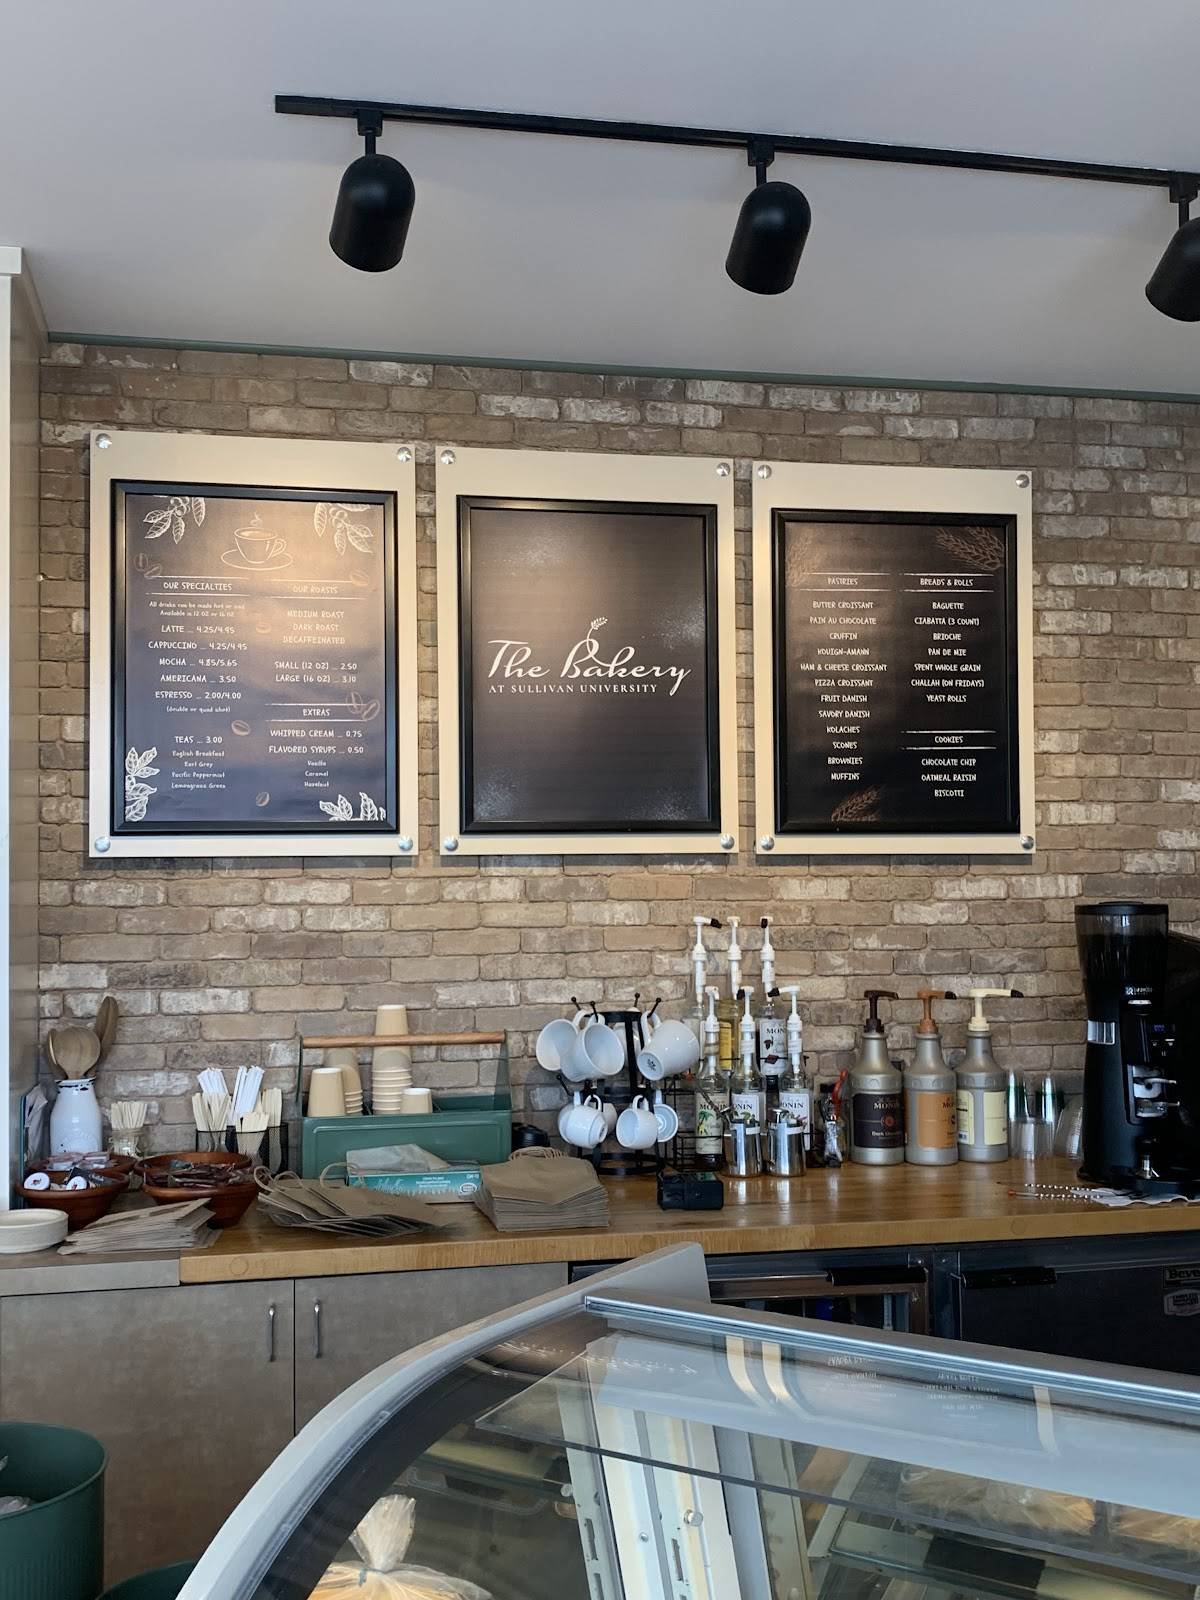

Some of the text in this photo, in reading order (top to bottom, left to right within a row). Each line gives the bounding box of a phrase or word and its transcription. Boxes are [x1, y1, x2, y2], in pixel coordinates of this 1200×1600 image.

[828, 577, 858, 585] PASTRIES
[920, 578, 945, 586] BREADS
[163, 582, 232, 591] OUR SPECIALTIES
[293, 585, 338, 594] OUR ROASTS
[812, 600, 874, 609] BUTTER CROISSANT
[932, 602, 964, 610] BAGUETTE
[288, 610, 344, 618] MEDIUM ROAST
[809, 616, 826, 624] PAIN
[839, 617, 877, 625] CHOCOLATE
[914, 617, 980, 626] CIABATTA (3 COUNT)
[161, 625, 184, 633] LATTE
[196, 626, 235, 634] 4.25/4.95
[293, 623, 312, 631] DARK
[283, 635, 345, 644] DECAFFEINATED
[830, 632, 857, 640] CRUFFIN
[148, 641, 197, 649] CAPPUCCINO
[818, 648, 870, 656] KOUIGN-AMANN
[928, 648, 941, 656] PAN
[159, 658, 186, 666] MOCHA
[274, 662, 299, 670] SMALL
[302, 662, 312, 670] (12
[488, 638, 692, 696] The Bakery
[800, 663, 815, 671] HAM
[824, 663, 849, 671] CHEESE
[914, 663, 981, 672] SPENT WHOLE GRAIN
[160, 674, 207, 682] AMERICANA
[275, 674, 300, 682] LARGE
[814, 679, 874, 687] PIZZA CROISSANT
[911, 679, 984, 687] CHALLAH (ON FRIDAYS)
[489, 684, 657, 693] AT SULLIVAN UNIVERSITY
[155, 691, 192, 699] ESPRESSO
[926, 694, 946, 702] YEAST
[303, 708, 330, 716] EXTRAS
[819, 710, 870, 718] SAVORY DANISH
[346, 730, 362, 738] 0.75
[174, 736, 194, 744] TEAS
[206, 736, 222, 744] 3.00
[833, 741, 857, 749] SCONES
[269, 745, 307, 753] FLAVORED
[311, 746, 336, 754] SYRUPS
[348, 746, 364, 754] 0.50
[172, 750, 193, 758] English
[828, 756, 863, 765] BROWNIES
[921, 758, 958, 766] CHOCOLATE
[831, 772, 860, 780] MUFFINS
[171, 782, 206, 790] Lemongrass
[934, 789, 964, 797] BISCOTTI
